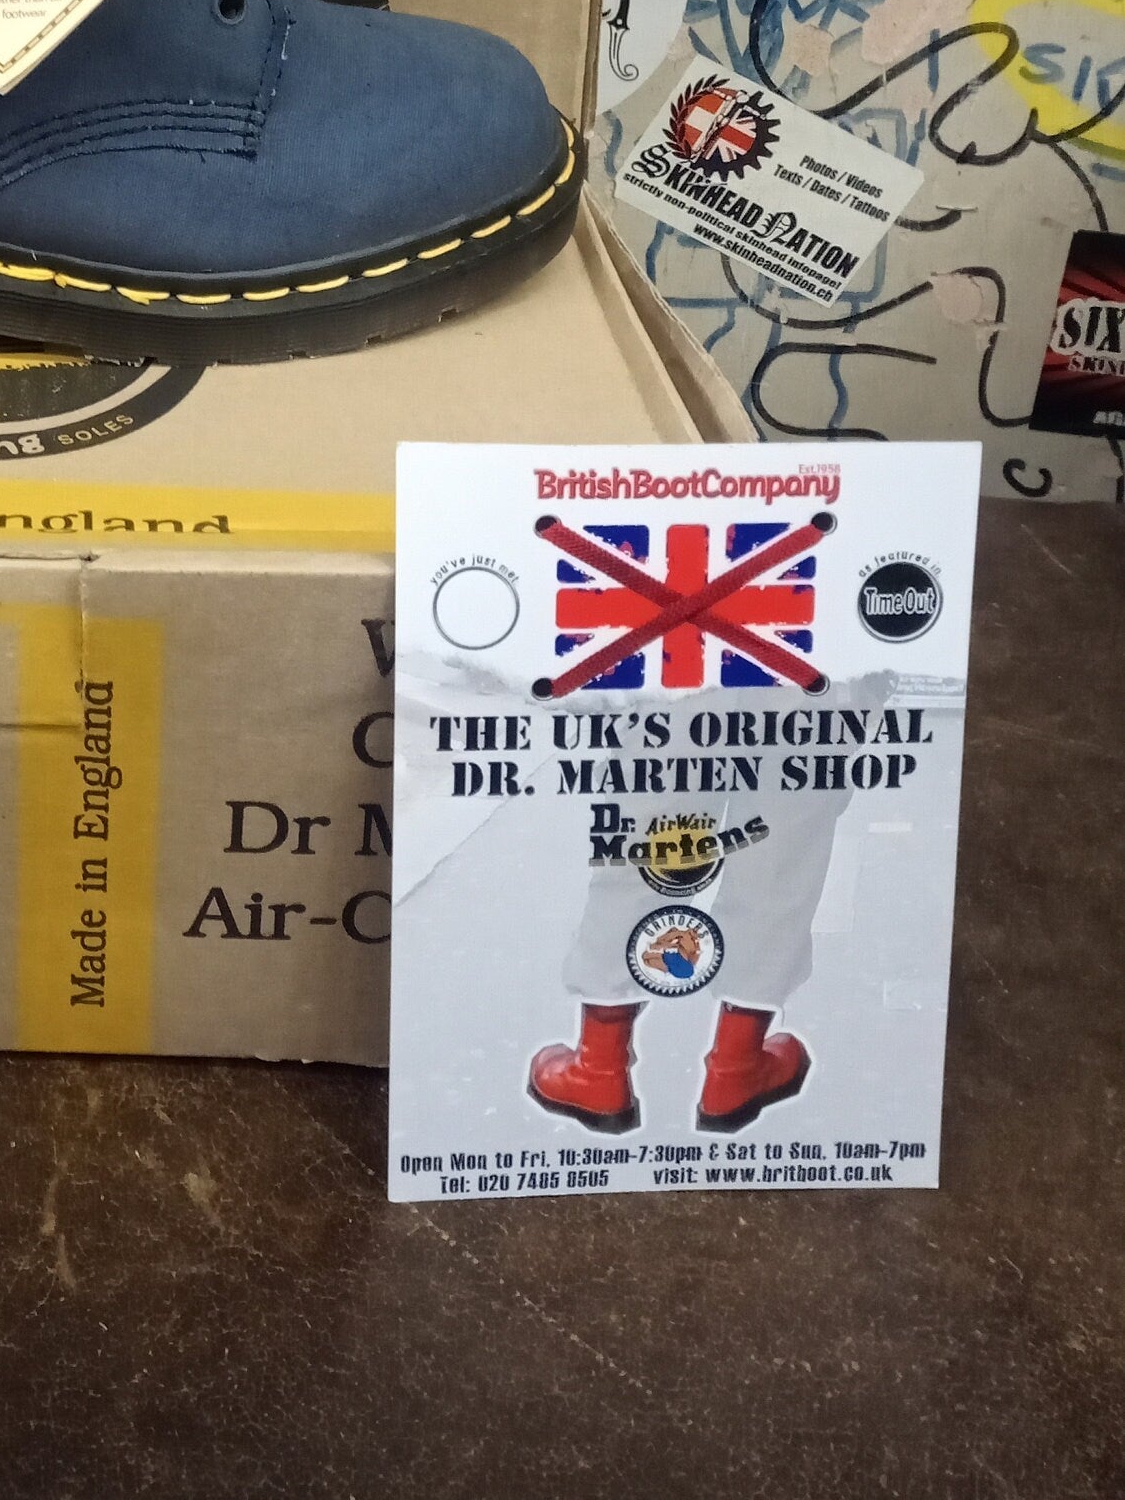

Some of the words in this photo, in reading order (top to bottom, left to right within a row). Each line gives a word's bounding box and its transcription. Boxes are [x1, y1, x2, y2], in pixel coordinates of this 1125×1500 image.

[774, 164, 803, 185] Texts
[810, 180, 842, 202] Dates
[849, 196, 890, 222] Tattoos
[799, 155, 838, 181] Photos
[845, 174, 883, 198] Videos
[623, 172, 664, 199] strictly
[664, 194, 735, 236] non-political
[735, 229, 788, 262] skinhead
[632, 144, 764, 229] SKINHEAD
[751, 212, 860, 278] NATION
[693, 223, 834, 303] www.skinheadnation.ch
[57, 412, 135, 446] SOLES
[535, 468, 841, 505] BritishBootCompany
[875, 551, 930, 568] featured
[430, 716, 530, 750] THE
[552, 713, 669, 748] UK'S
[689, 710, 931, 745] ORIGINAL
[73, 677, 125, 840] England
[452, 762, 534, 795] DR.
[557, 757, 761, 793] MARTEN
[781, 755, 915, 789] SHOP
[224, 800, 331, 856] Dr
[588, 815, 770, 867] Martens
[645, 812, 716, 836] AirWair
[78, 862, 108, 895] in
[645, 913, 709, 940] GRINDERS
[70, 908, 108, 1009] Made
[401, 1155, 442, 1174] Open
[450, 1153, 486, 1171] Mon
[495, 1152, 512, 1168] to
[725, 1143, 755, 1160] Sat
[763, 1143, 782, 1159] to
[440, 1176, 469, 1193] Tel:
[478, 1174, 509, 1191] 020
